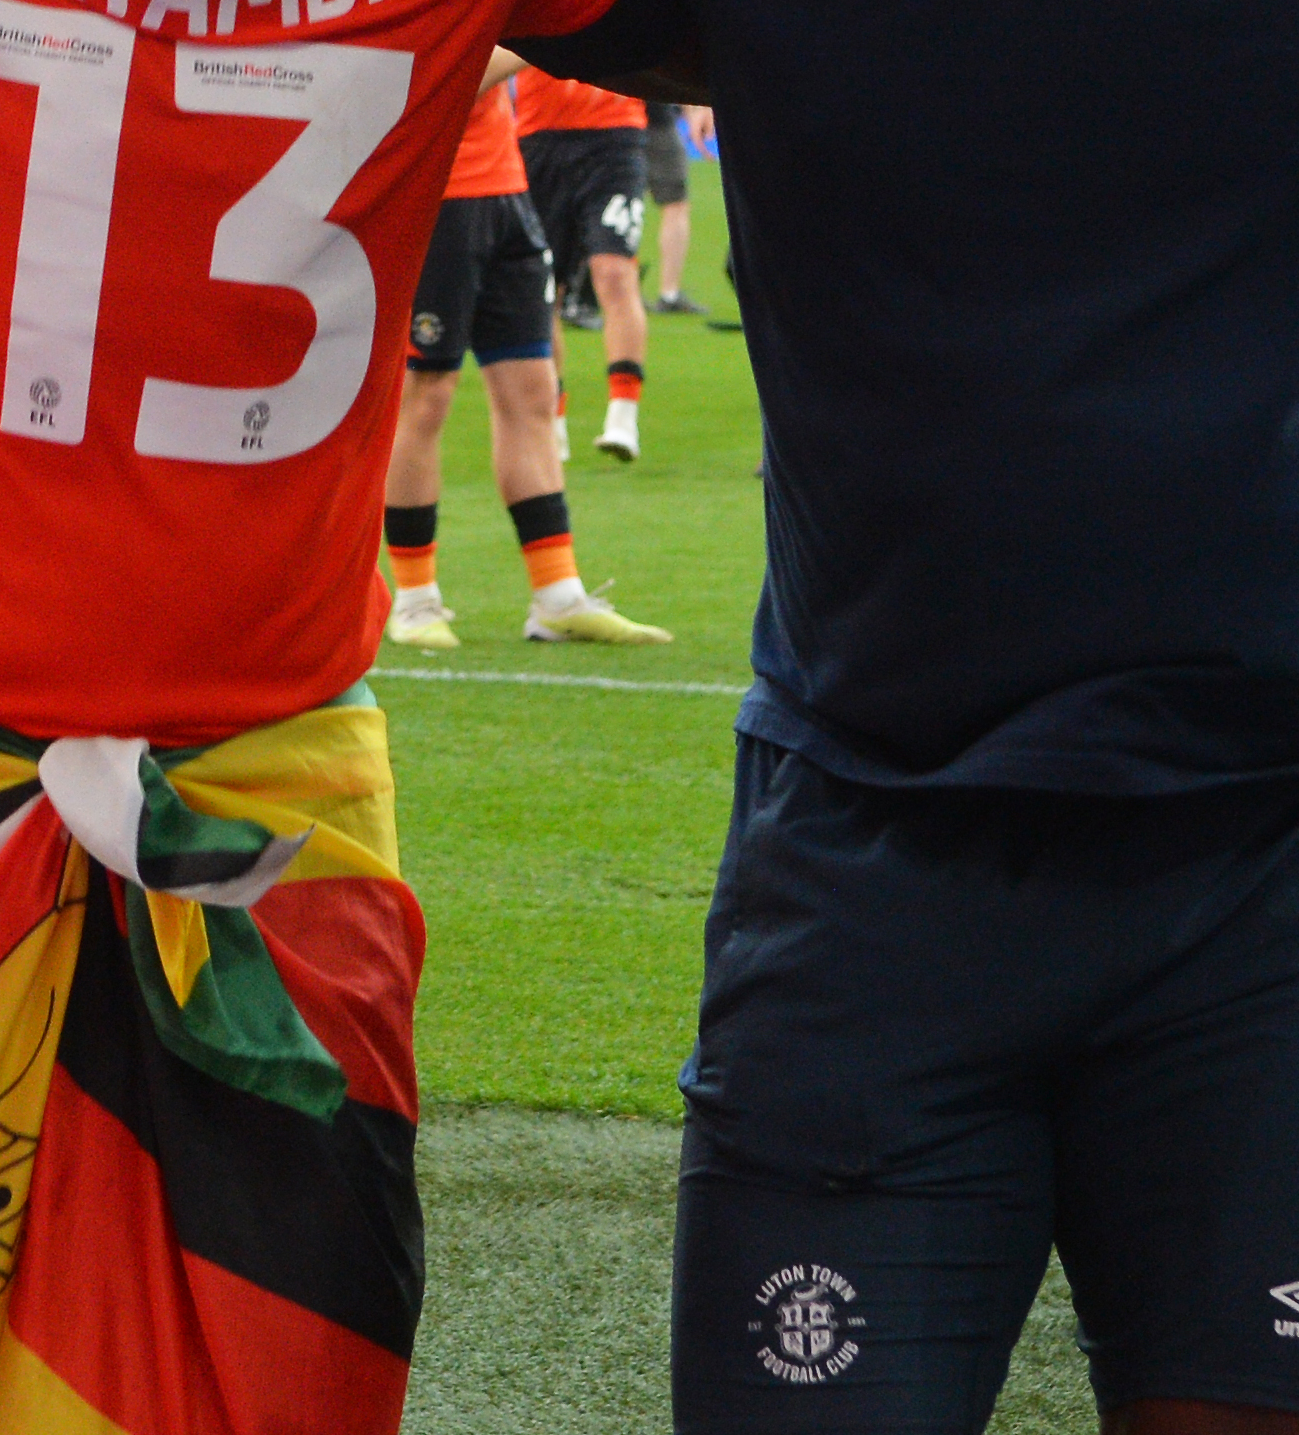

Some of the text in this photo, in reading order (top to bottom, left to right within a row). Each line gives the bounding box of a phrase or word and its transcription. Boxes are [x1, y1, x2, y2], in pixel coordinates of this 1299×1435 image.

[29, 410, 55, 427] EFL
[240, 435, 263, 450] EFL
[755, 1264, 857, 1305] LUTON TOWN
[757, 1340, 859, 1384] FOOTBALL CLUB
